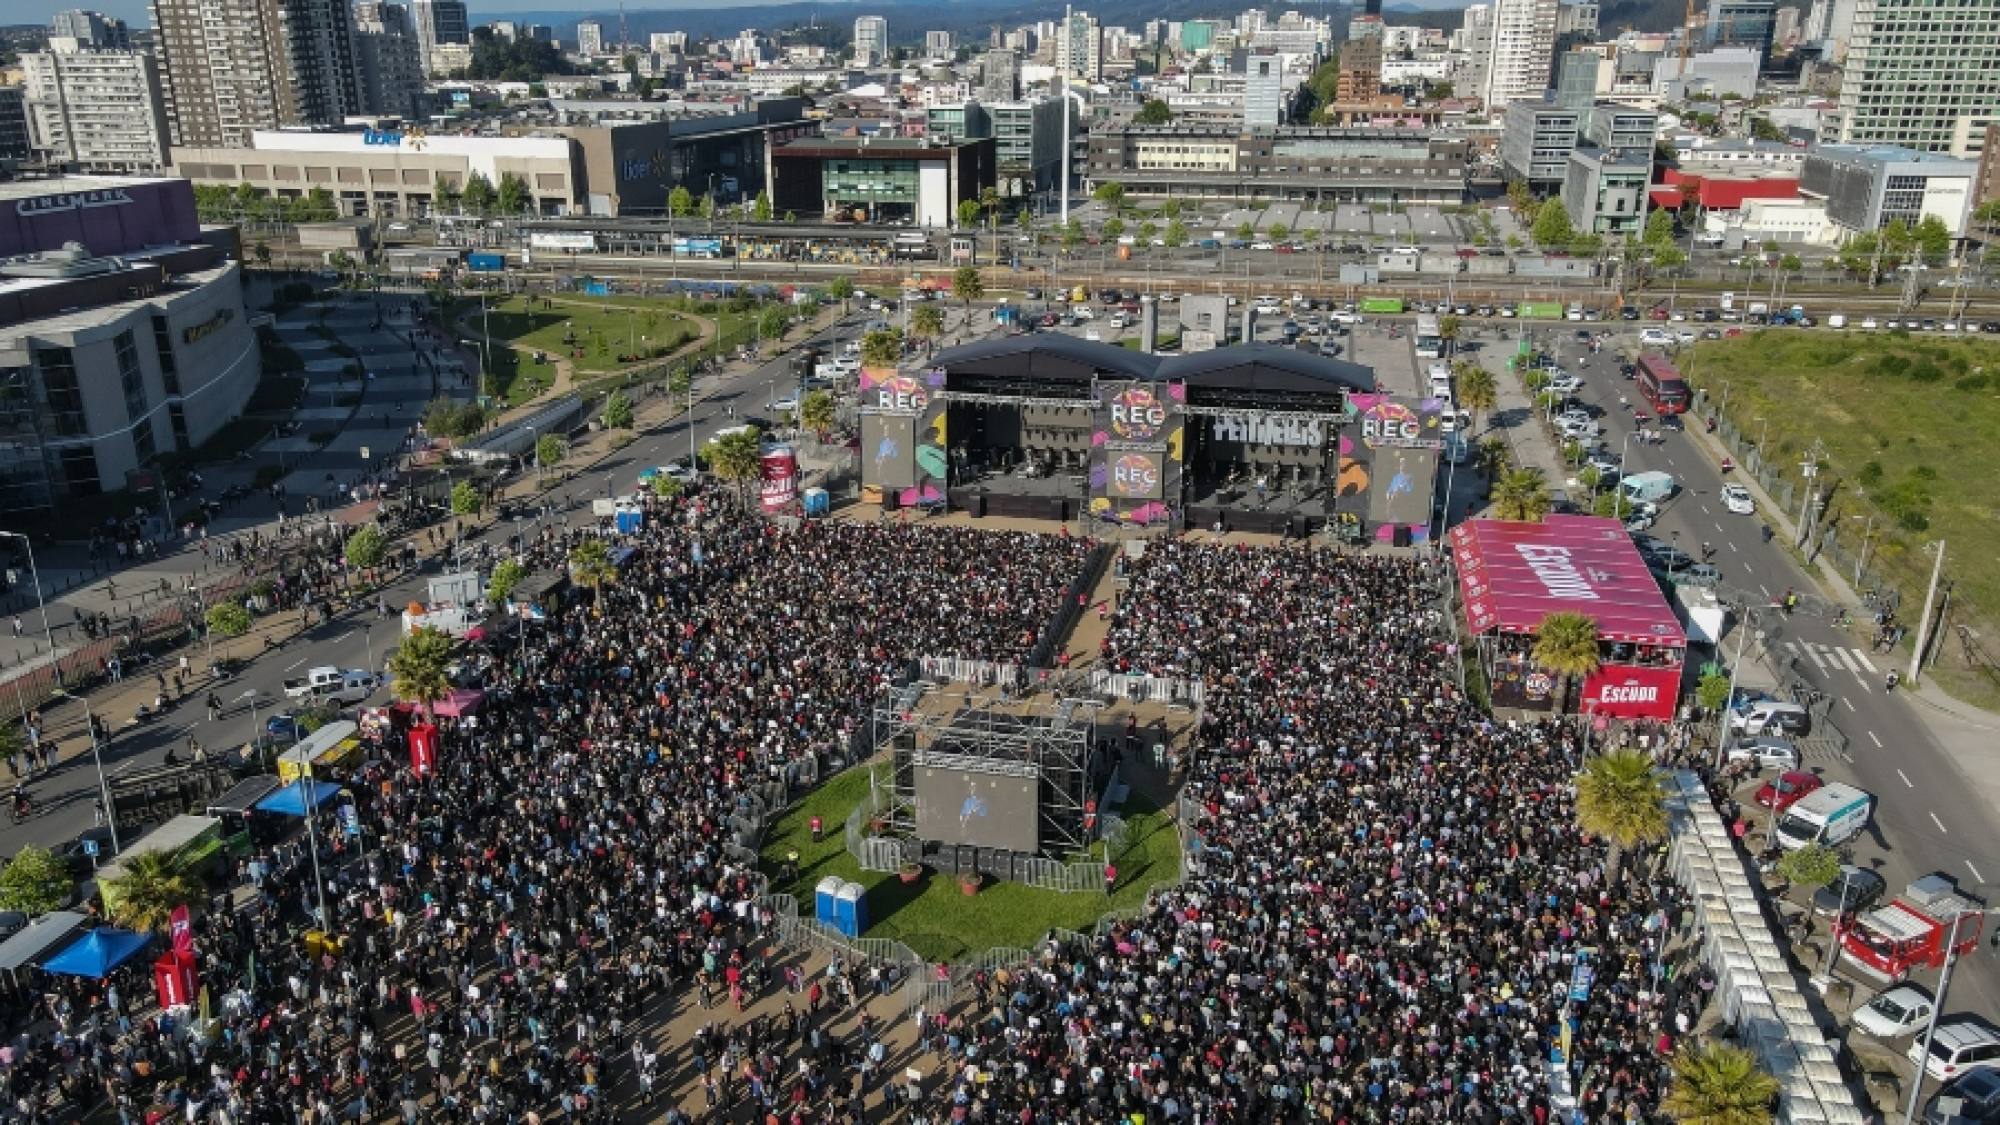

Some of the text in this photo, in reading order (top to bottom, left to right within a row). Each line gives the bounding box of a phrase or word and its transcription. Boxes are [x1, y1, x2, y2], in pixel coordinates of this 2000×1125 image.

[16, 189, 134, 216] CINEMARK
[879, 389, 927, 411] REC
[1112, 404, 1164, 425] REC
[1362, 418, 1419, 439] REC
[1115, 466, 1157, 483] REC
[1601, 684, 1658, 703] ESCUDO
